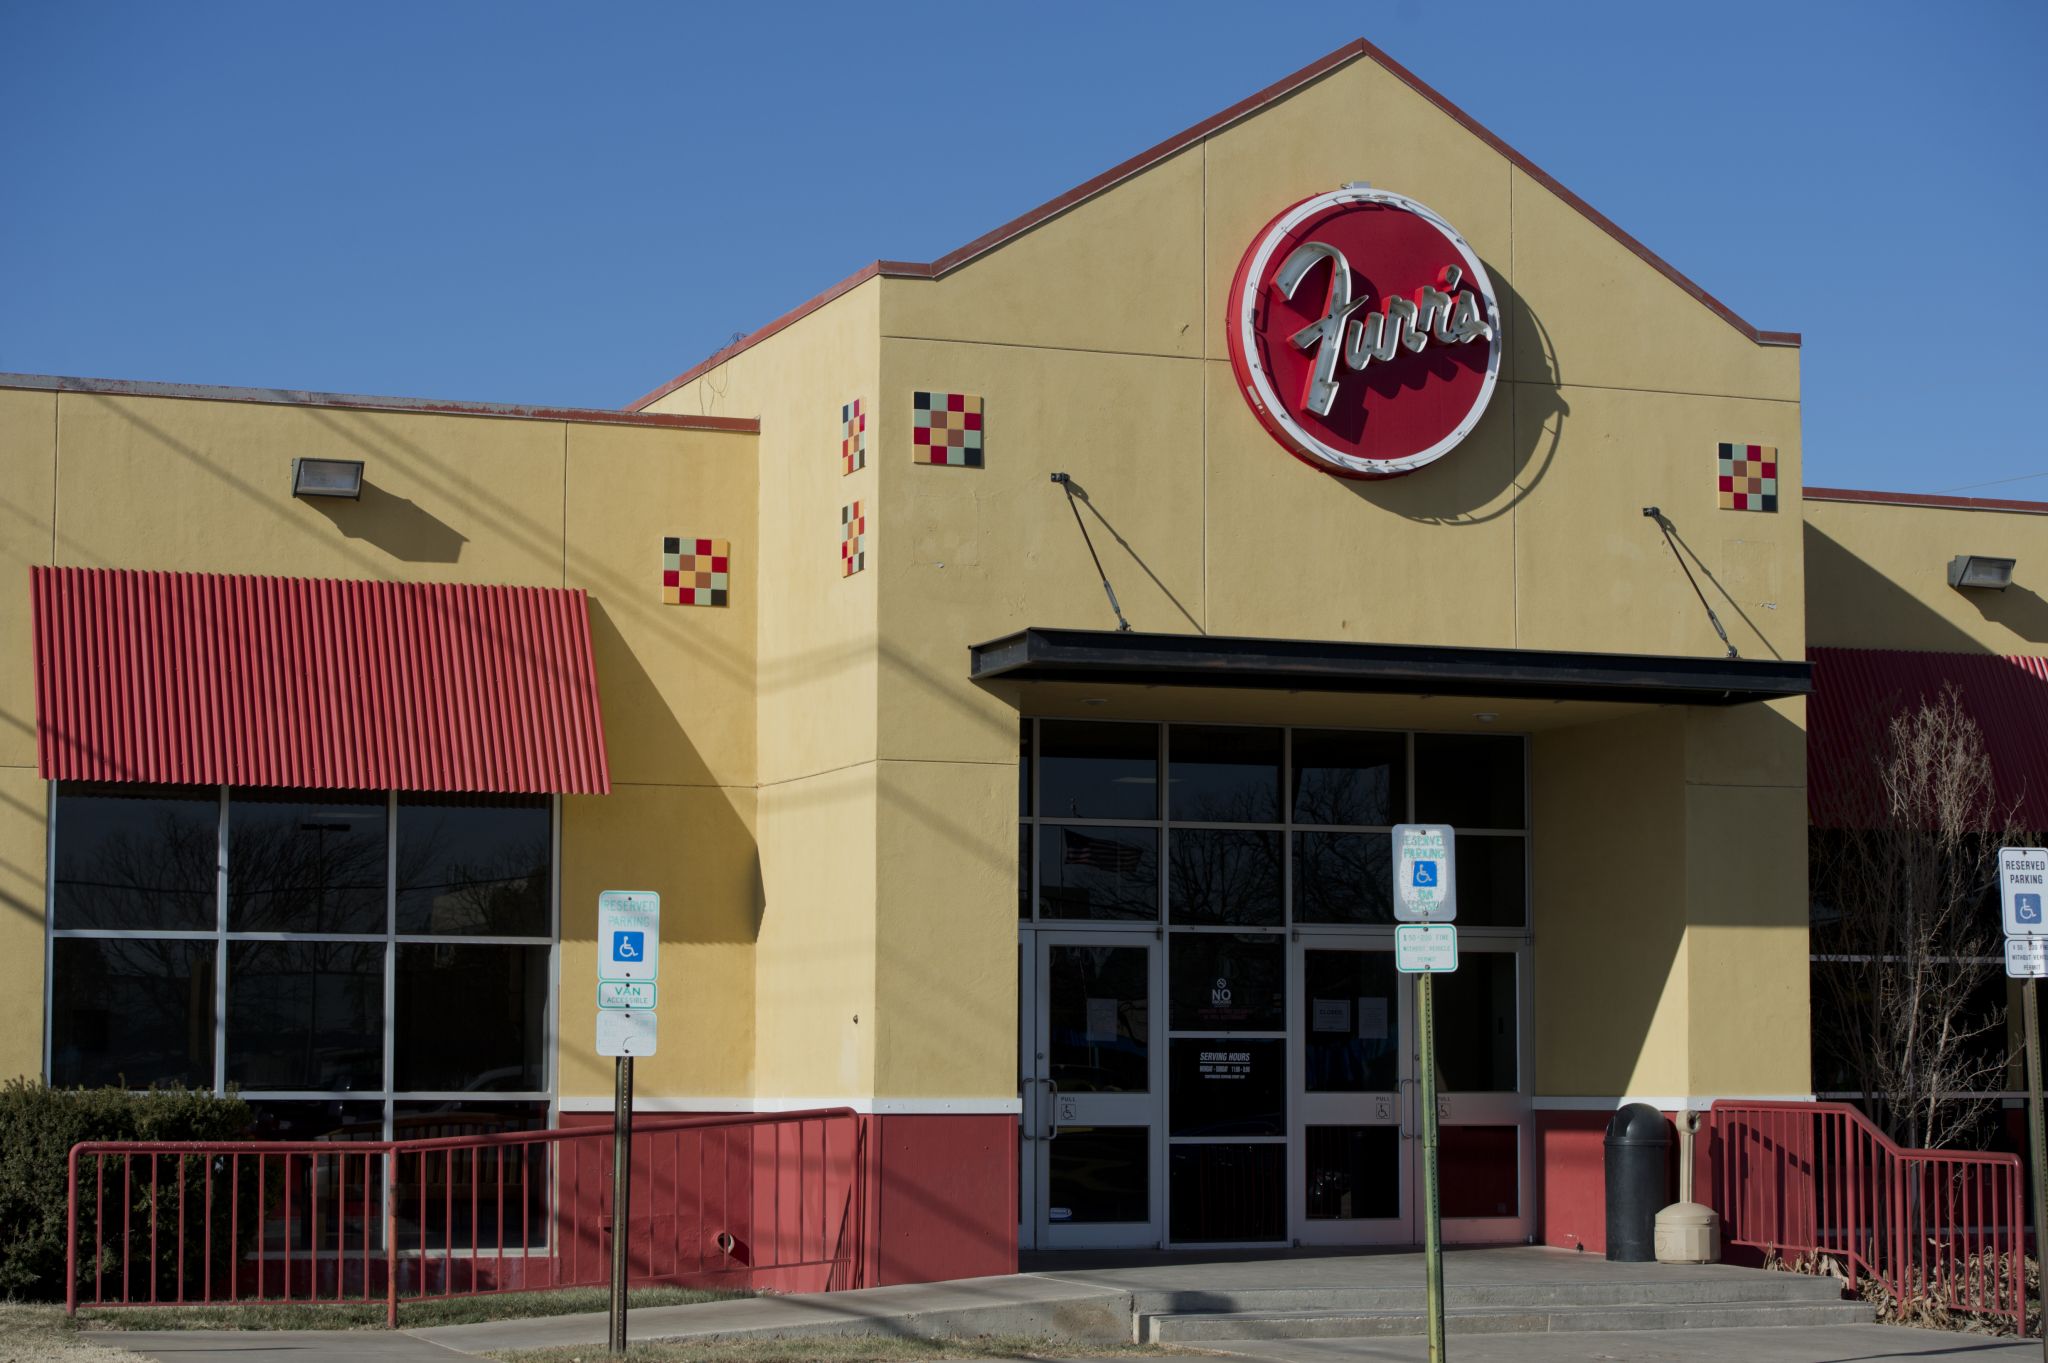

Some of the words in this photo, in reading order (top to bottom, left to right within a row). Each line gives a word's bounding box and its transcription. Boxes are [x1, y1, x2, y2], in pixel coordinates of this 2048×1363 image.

[1269, 241, 1493, 416] Furr's
[2005, 860, 2046, 871] RESERVED
[2010, 874, 2043, 884] PARKING
[602, 899, 656, 912] RESERVED
[608, 914, 650, 928] PARKING
[615, 987, 641, 996] VAN
[1211, 989, 1232, 1001] NO
[1199, 1052, 1228, 1061] SERVING
[1228, 1052, 1251, 1061] HOURS
